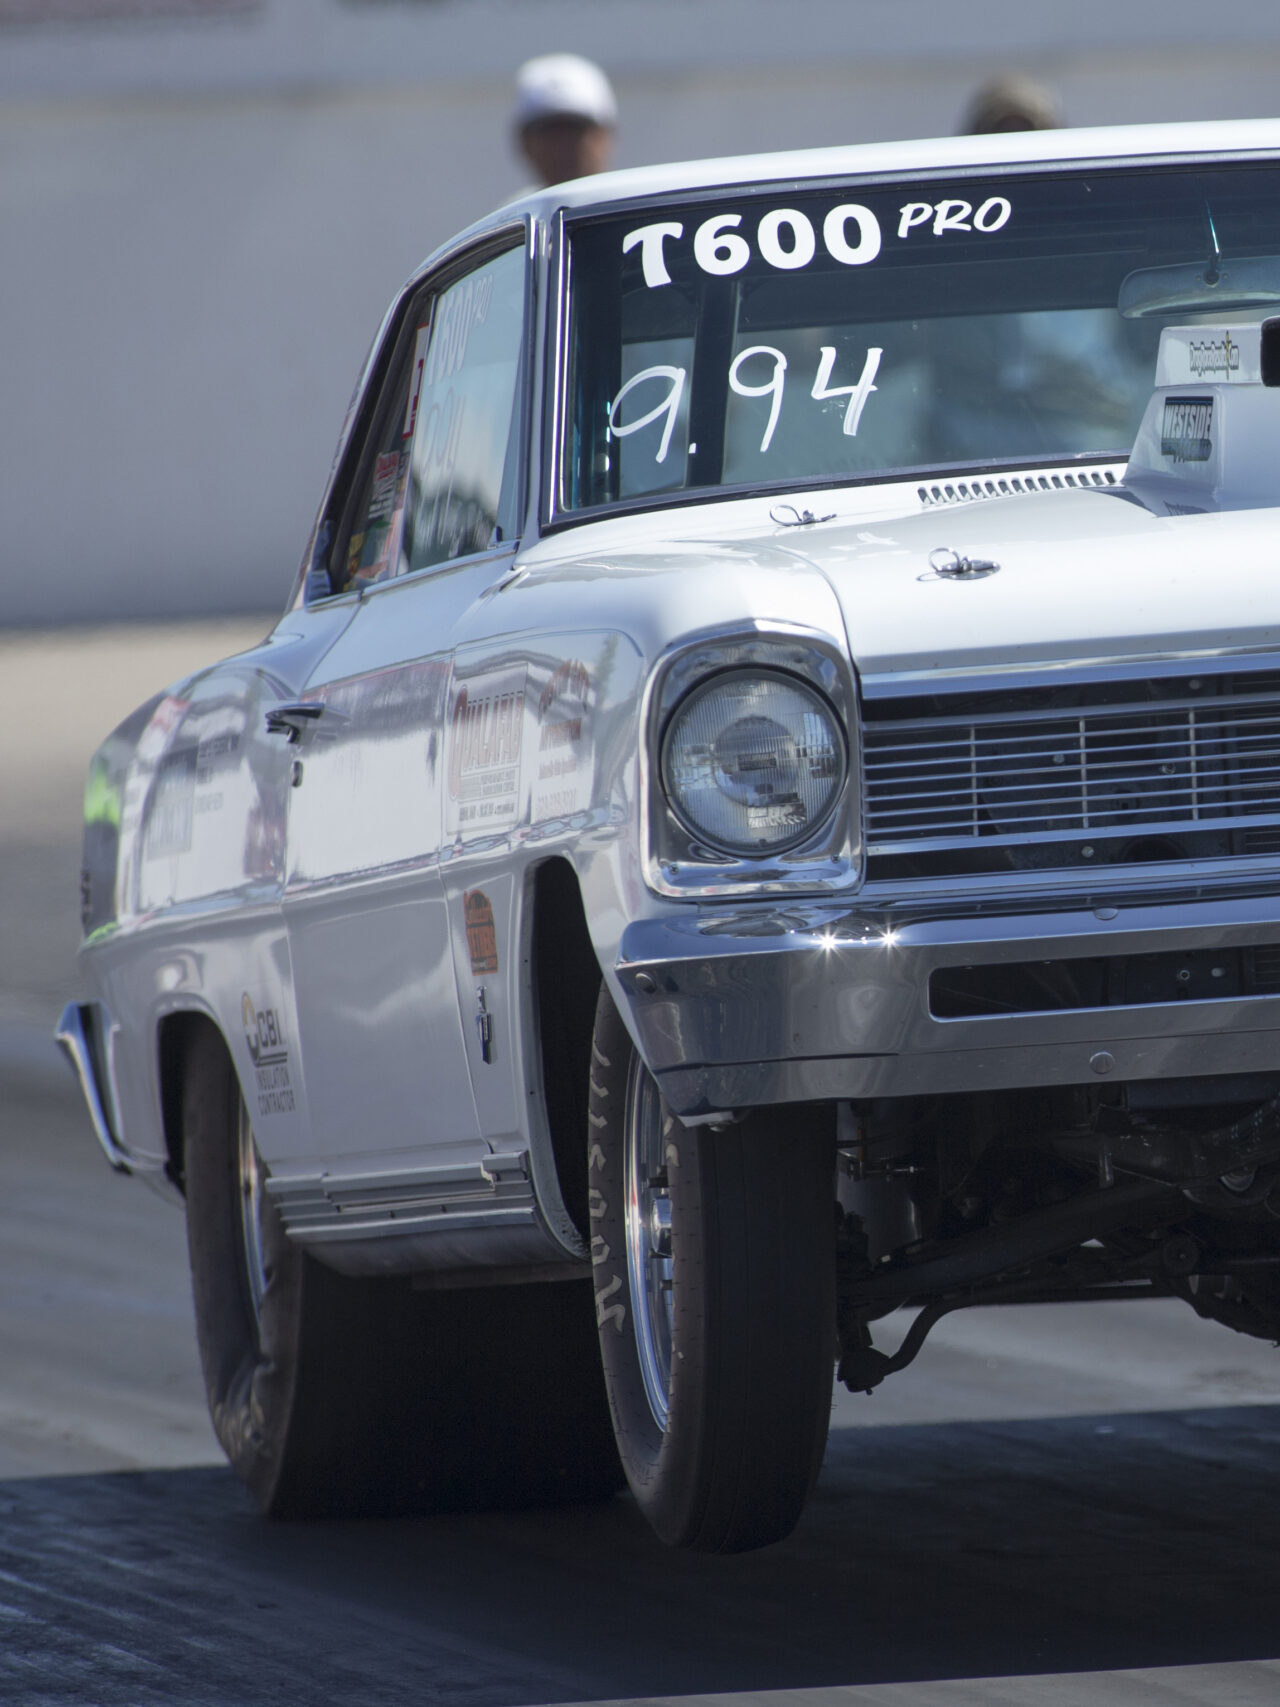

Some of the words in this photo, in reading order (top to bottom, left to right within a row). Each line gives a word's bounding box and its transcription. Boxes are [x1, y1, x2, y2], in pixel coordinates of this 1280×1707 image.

[622, 203, 882, 288] T600
[898, 197, 1011, 238] PRO
[609, 345, 883, 464] 9.94
[1162, 404, 1213, 439] WESTSIDE
